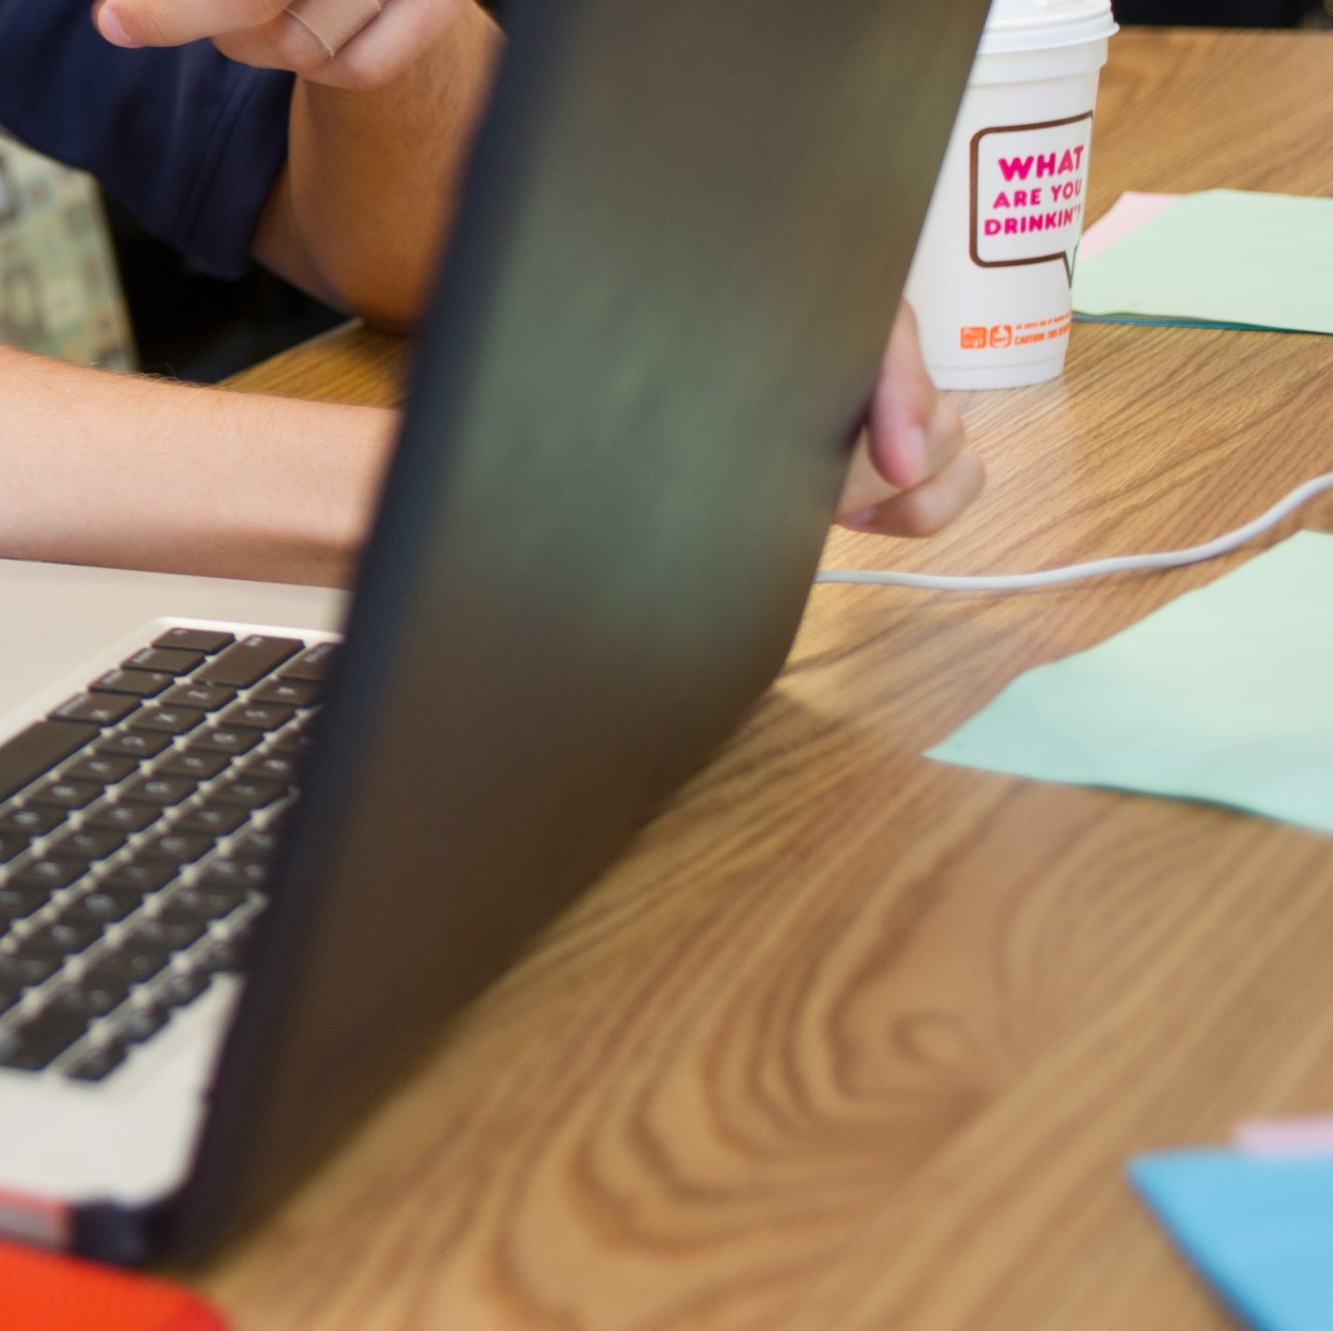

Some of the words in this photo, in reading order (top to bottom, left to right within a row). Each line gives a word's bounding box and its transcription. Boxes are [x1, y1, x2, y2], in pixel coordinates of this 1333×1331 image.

[998, 145, 1084, 182] WHAT
[992, 188, 1042, 210] ARE
[1050, 177, 1082, 203] YOU
